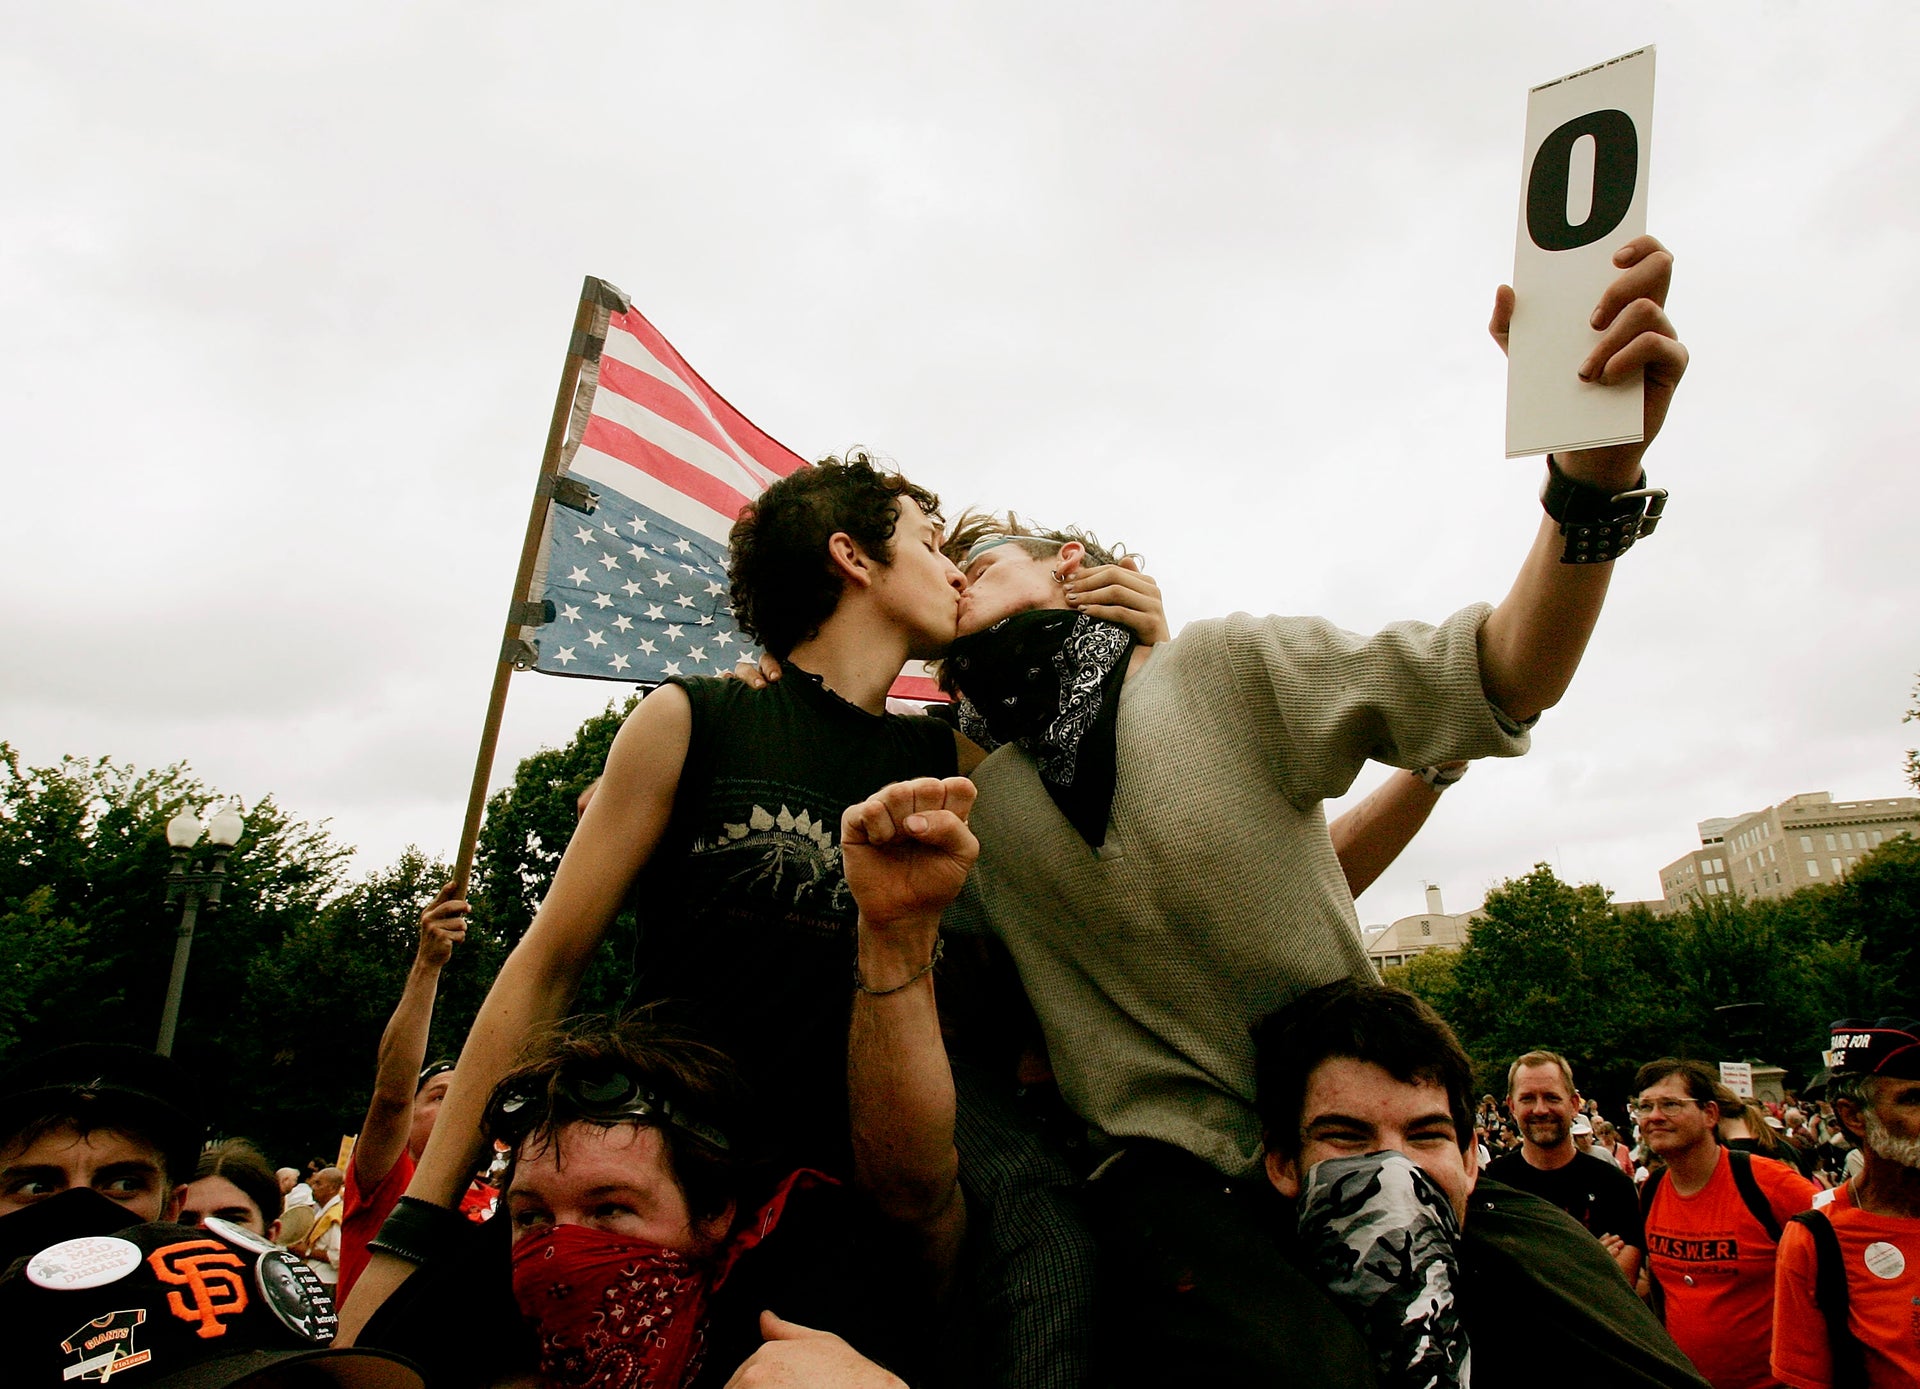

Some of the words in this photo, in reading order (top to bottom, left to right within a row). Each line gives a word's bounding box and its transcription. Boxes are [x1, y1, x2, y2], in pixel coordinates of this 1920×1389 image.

[1849, 1034, 1871, 1048] FOR
[67, 1243, 113, 1260] MAD
[71, 1247, 129, 1269] COWBOY
[1649, 1235, 1736, 1259] A.N.S.W.E.R.
[63, 1259, 128, 1283] DISEASE
[84, 1327, 129, 1350] GIANTS
[113, 1354, 148, 1369] Violence
